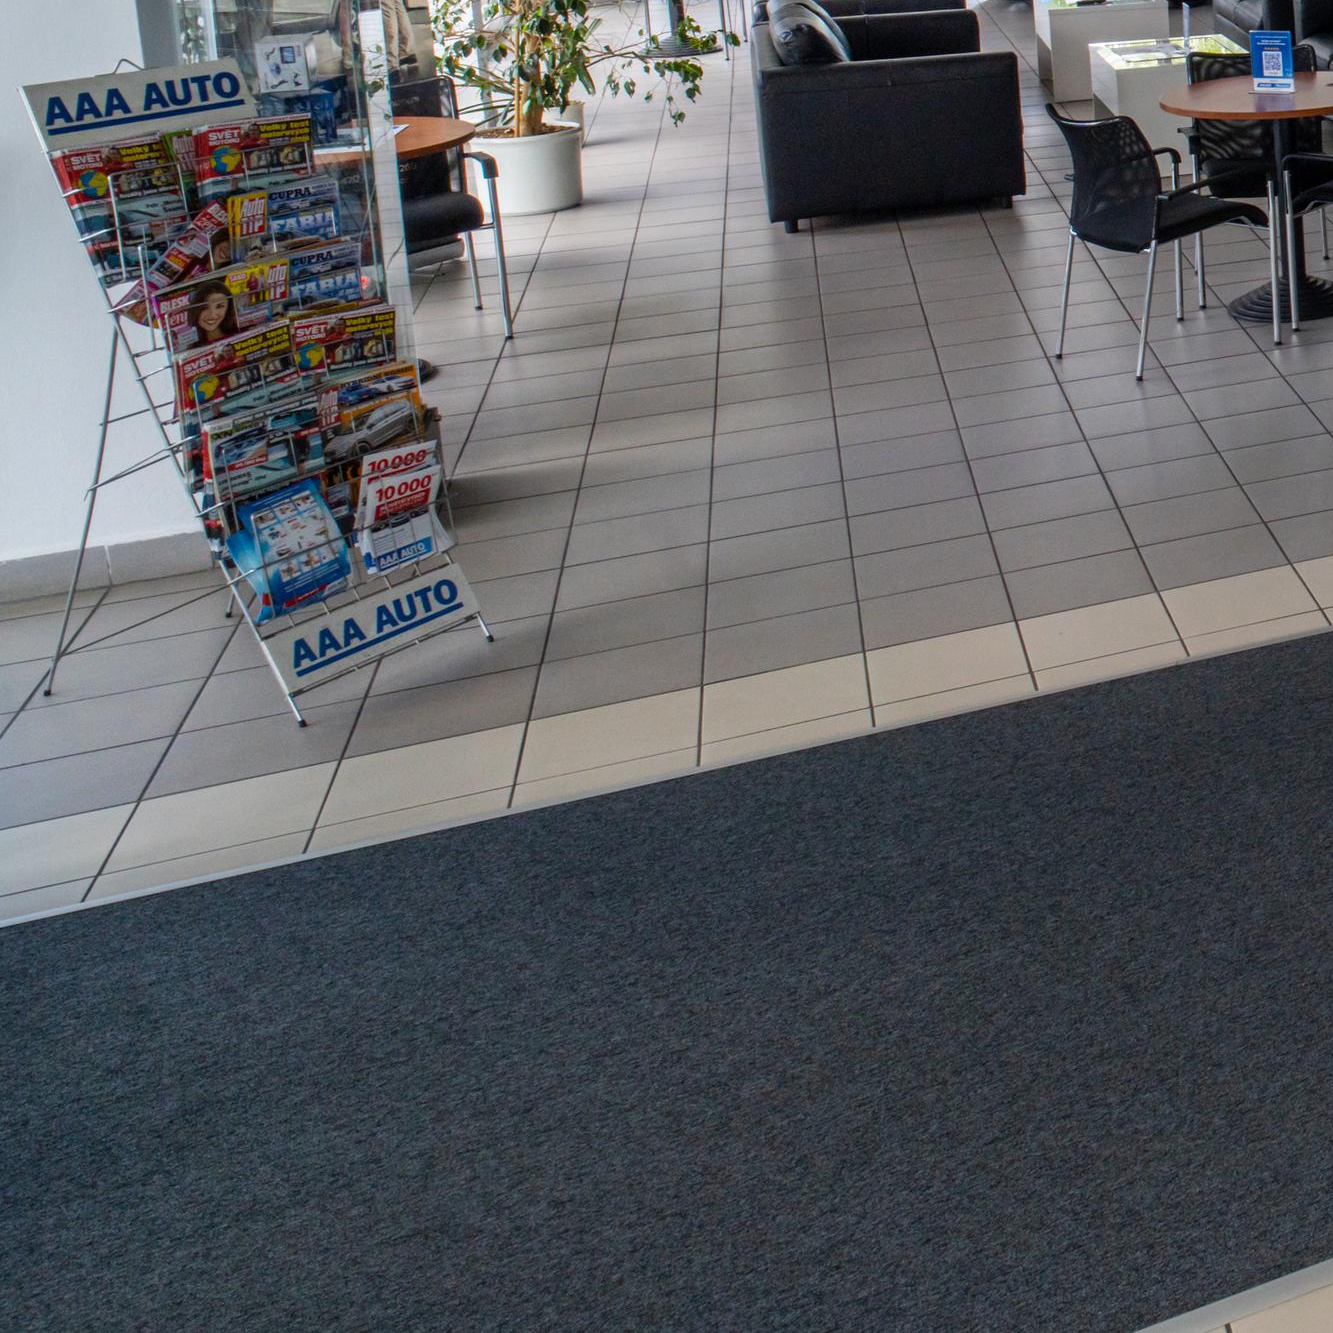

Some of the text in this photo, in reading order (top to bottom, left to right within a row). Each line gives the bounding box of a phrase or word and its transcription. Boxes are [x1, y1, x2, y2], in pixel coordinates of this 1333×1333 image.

[46, 71, 240, 127] AAA AUTO
[208, 128, 240, 141] SVĚT
[70, 152, 102, 165] SVĚT
[268, 187, 312, 201] CUPRA
[240, 198, 265, 217] Auto
[293, 250, 334, 267] CUPRA
[233, 326, 288, 351] Velký test
[296, 324, 327, 336] SVĚT
[236, 334, 289, 357] motorových
[184, 356, 214, 373] SVĚT
[367, 449, 428, 472] 10 000
[376, 474, 432, 502] 10 000
[380, 542, 426, 567] AAA AUTO
[293, 579, 459, 669] AAA AUTO
